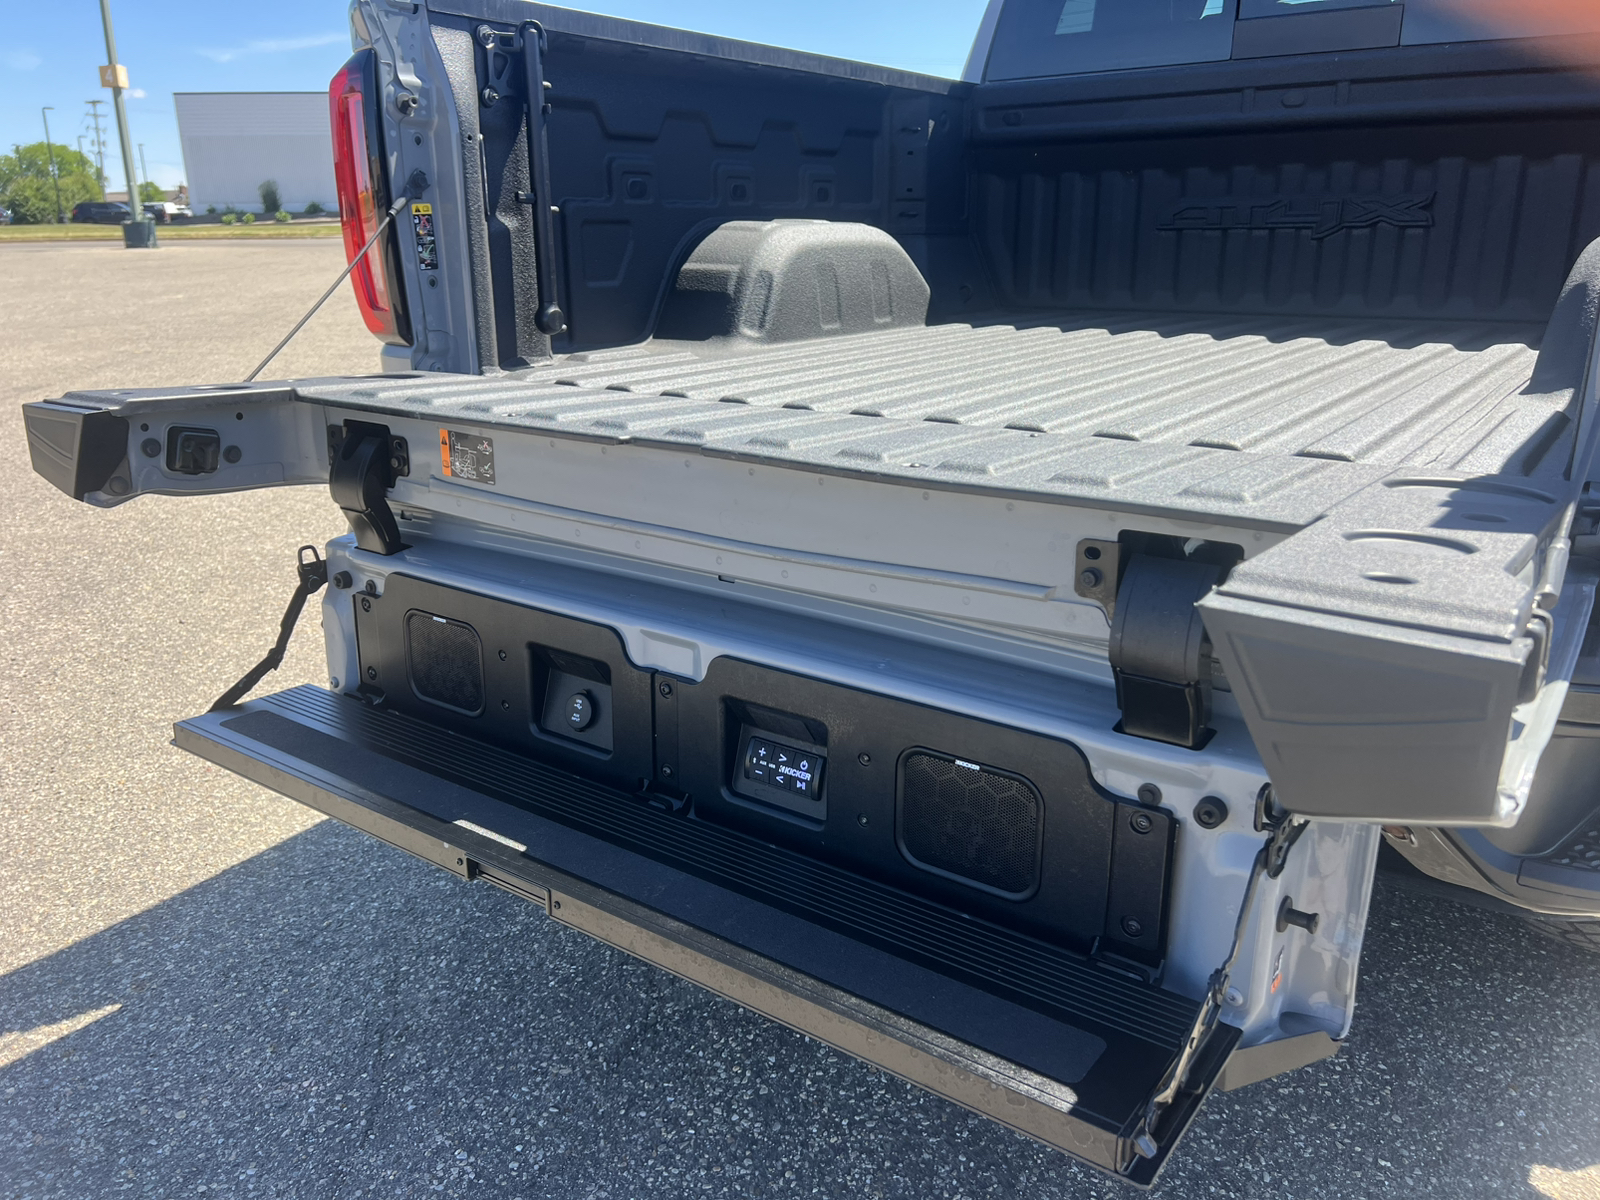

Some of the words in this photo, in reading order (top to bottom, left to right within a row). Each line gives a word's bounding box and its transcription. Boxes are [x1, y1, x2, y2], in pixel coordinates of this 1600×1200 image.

[105, 68, 114, 83] 4
[1157, 192, 1437, 240] AT4X
[779, 765, 811, 781] KICKER
